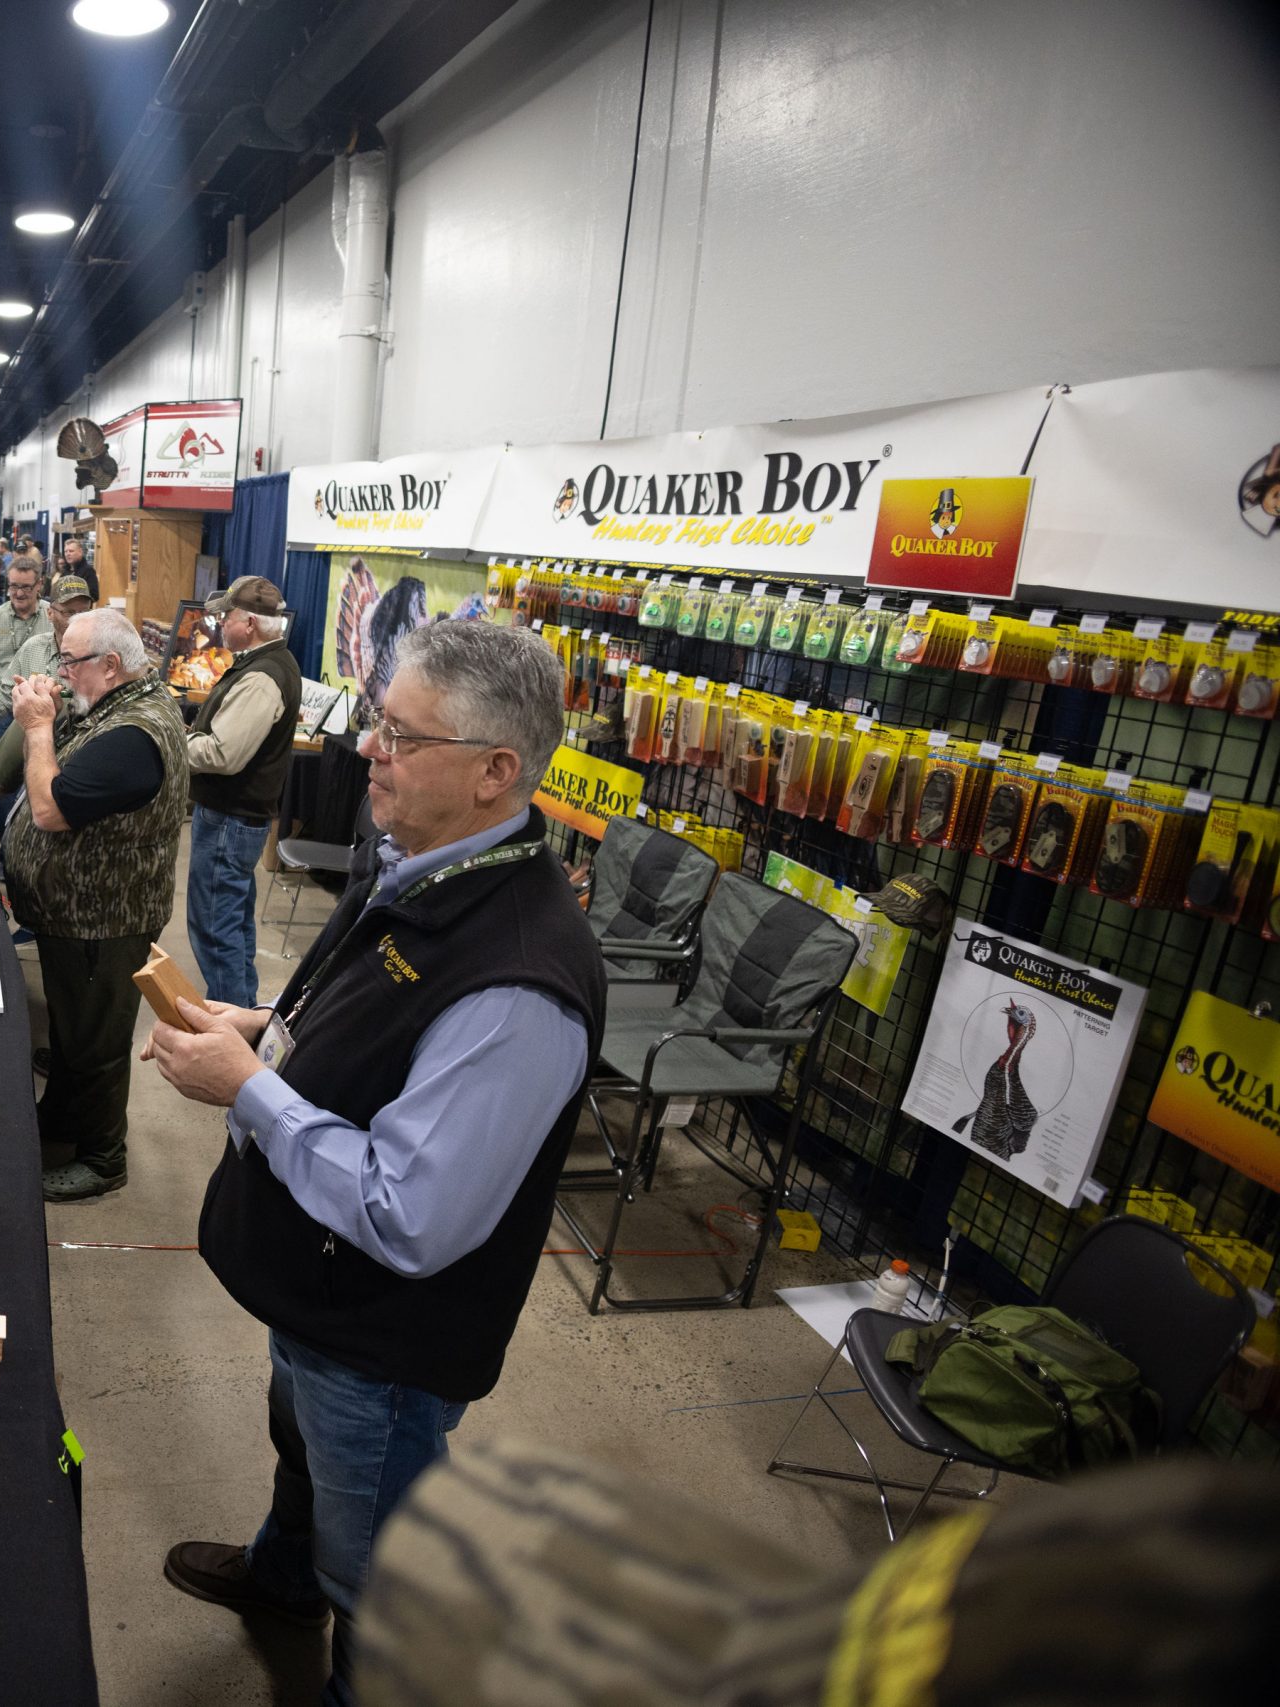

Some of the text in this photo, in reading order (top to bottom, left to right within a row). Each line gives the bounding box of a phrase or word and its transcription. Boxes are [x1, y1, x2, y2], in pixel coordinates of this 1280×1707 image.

[325, 474, 447, 521] QUAKER BOY
[577, 452, 880, 526] QUAKER BOY
[675, 516, 730, 546] First
[730, 515, 817, 546] Choice
[890, 534, 1000, 558] QUAKER BOY
[546, 766, 634, 816] AKER BOY
[402, 965, 420, 982] BOY
[998, 946, 1090, 992] QUAKER BOY
[1014, 968, 1114, 1010] Hunter's First Choice
[1073, 1009, 1111, 1030] PATTERNING
[1084, 1022, 1110, 1037] TARGET
[1199, 1051, 1280, 1116] QUA
